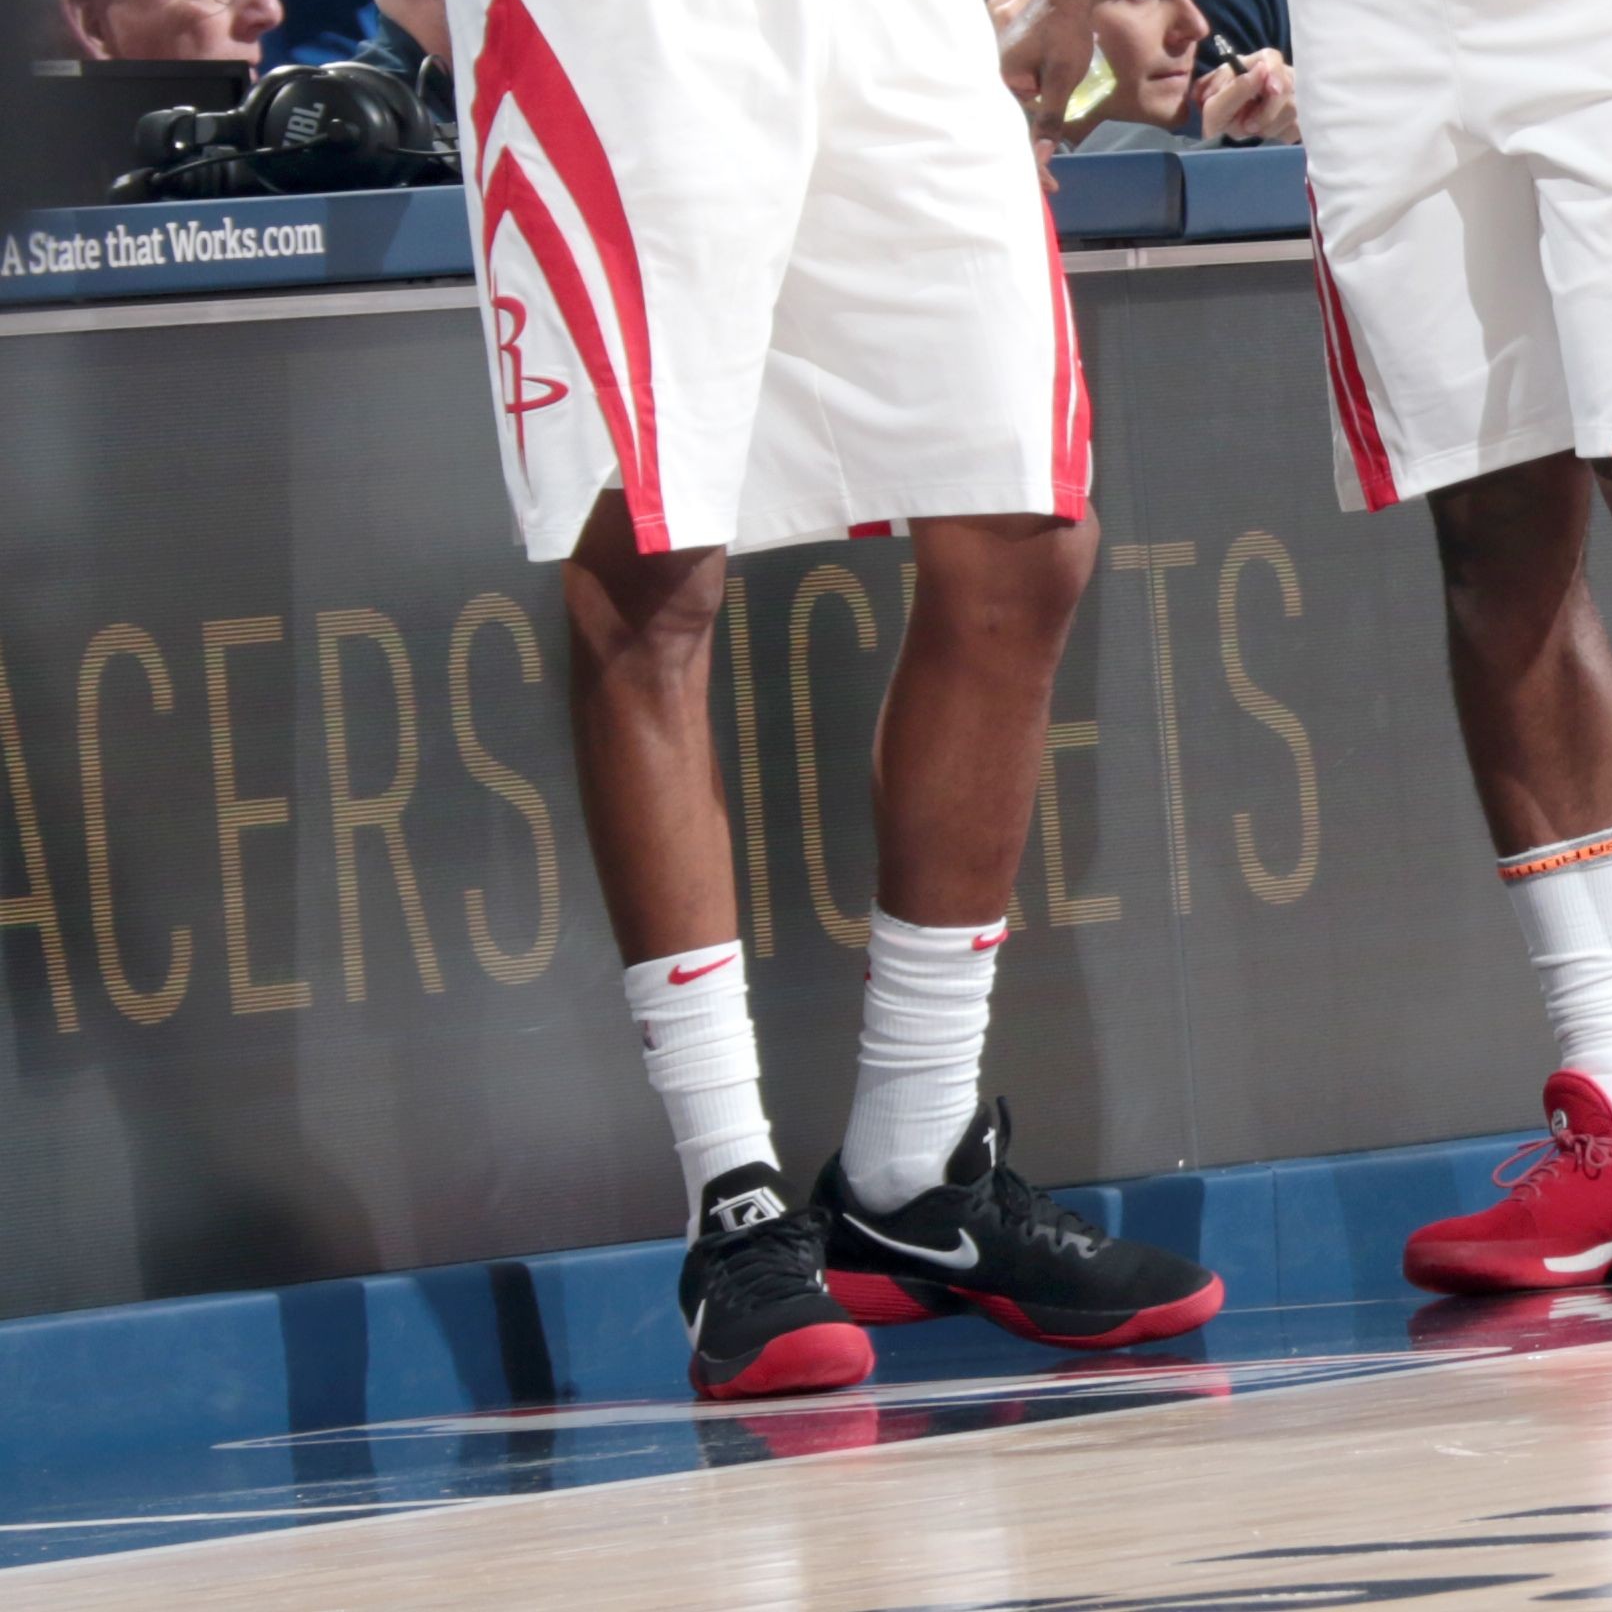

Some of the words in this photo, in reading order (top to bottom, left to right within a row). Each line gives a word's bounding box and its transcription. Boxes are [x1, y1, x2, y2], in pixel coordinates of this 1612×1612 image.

[0, 234, 26, 276] A
[28, 232, 101, 274] State
[105, 225, 166, 268] that
[165, 217, 325, 263] Works.com
